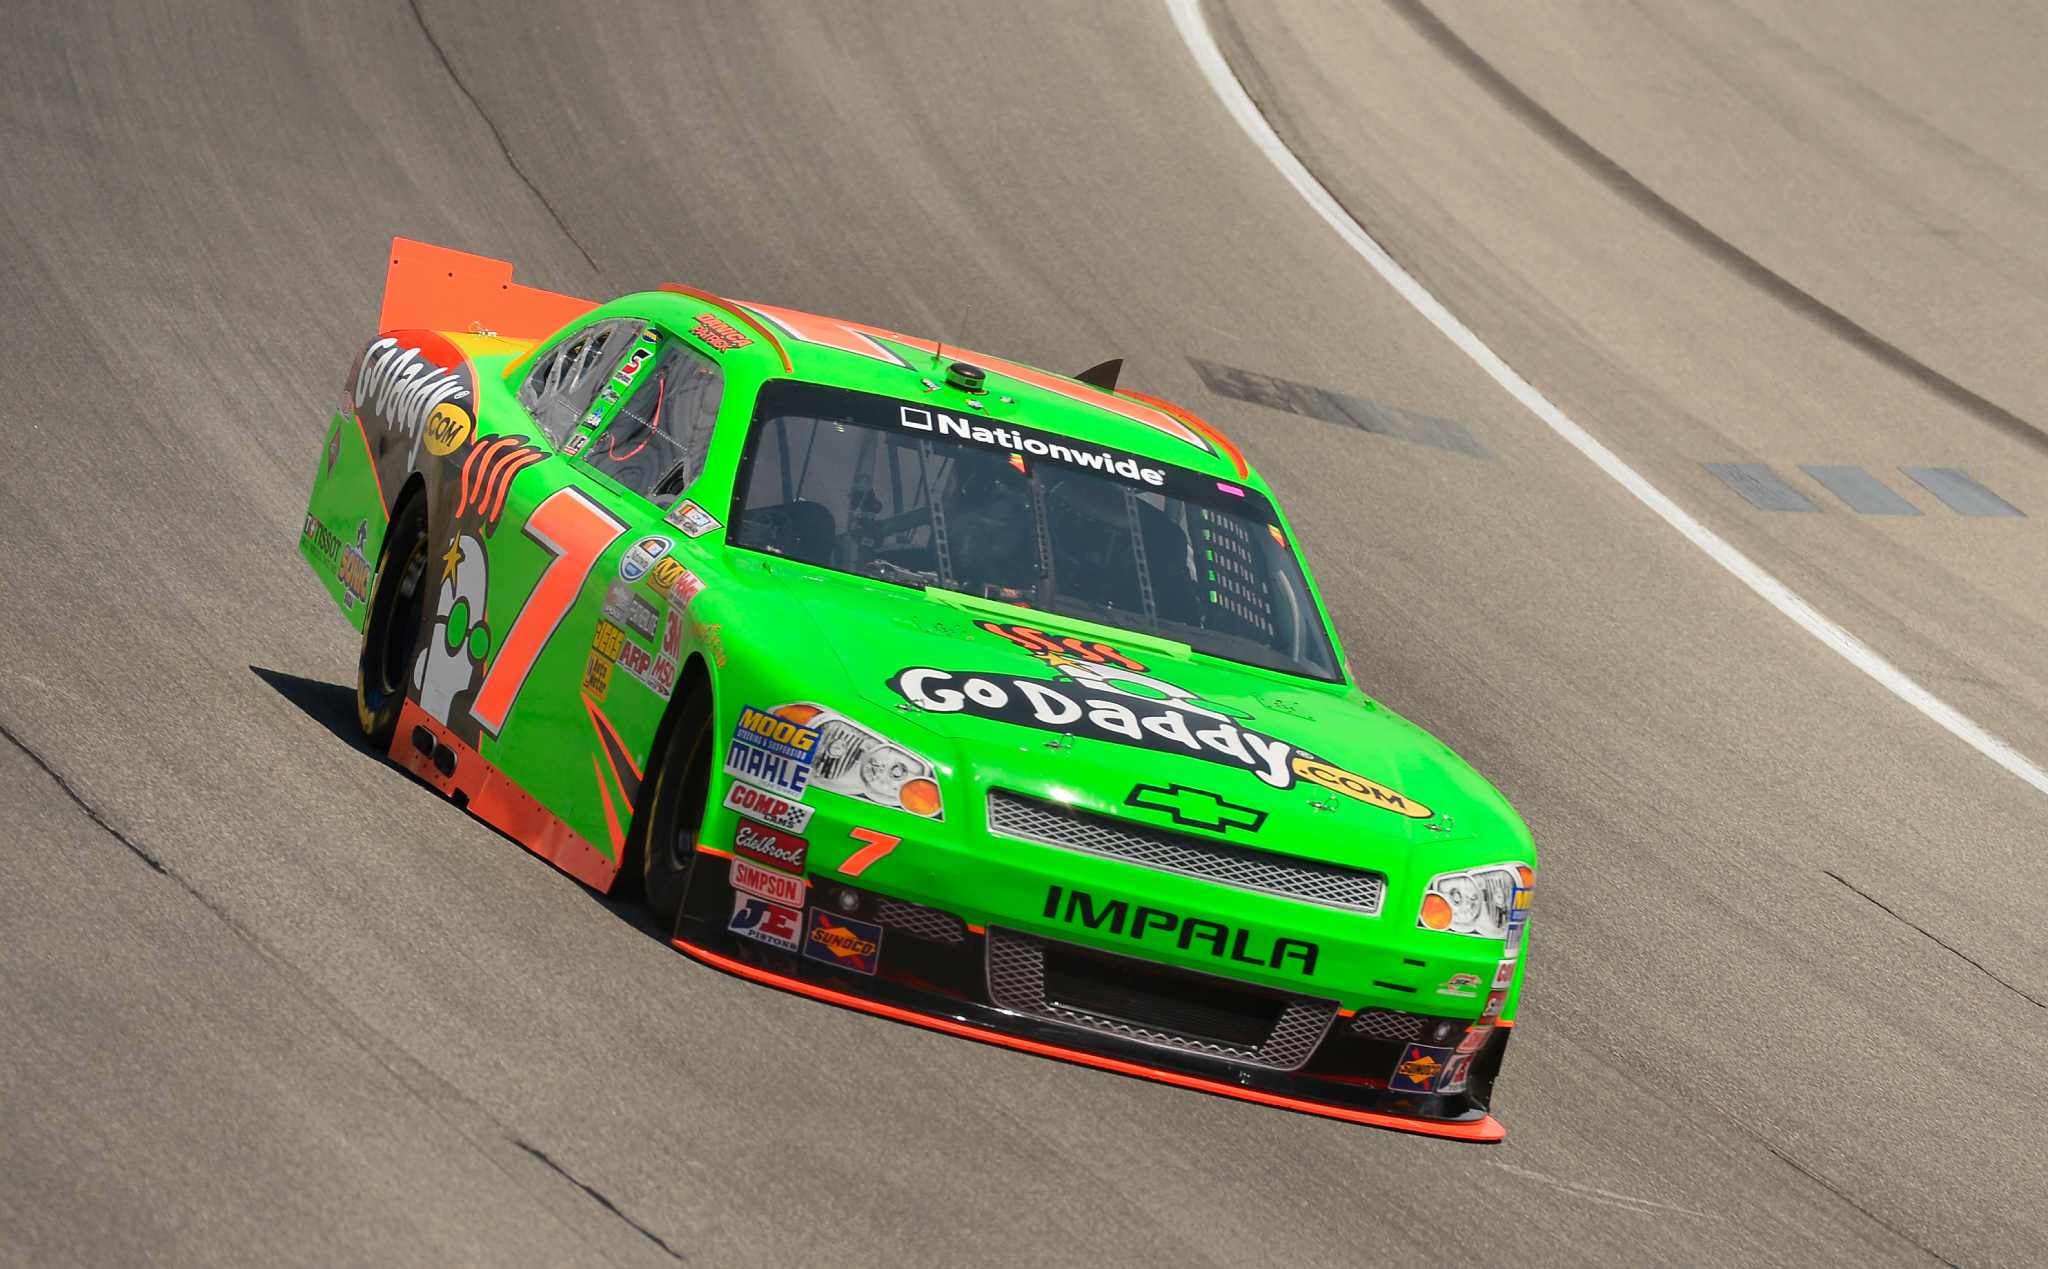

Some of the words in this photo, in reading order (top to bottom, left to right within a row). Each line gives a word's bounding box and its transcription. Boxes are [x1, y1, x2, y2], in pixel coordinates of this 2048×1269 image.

[692, 325, 730, 352] PATRICK
[696, 313, 753, 349] DANICA
[937, 413, 1163, 487] Nationwide
[469, 484, 632, 742] 7
[619, 642, 651, 676] ARP
[652, 656, 676, 689] MSD
[739, 709, 819, 751] MOOG
[727, 743, 810, 793] MAHLE
[730, 785, 789, 817] COMP
[763, 811, 796, 829] CAMS
[736, 827, 804, 867] Edelbrock
[838, 826, 902, 878] 7
[736, 863, 798, 900] SIMPSON
[731, 899, 800, 940] JE
[1043, 885, 1320, 976] IMPALA
[814, 927, 875, 955] SUNOCO
